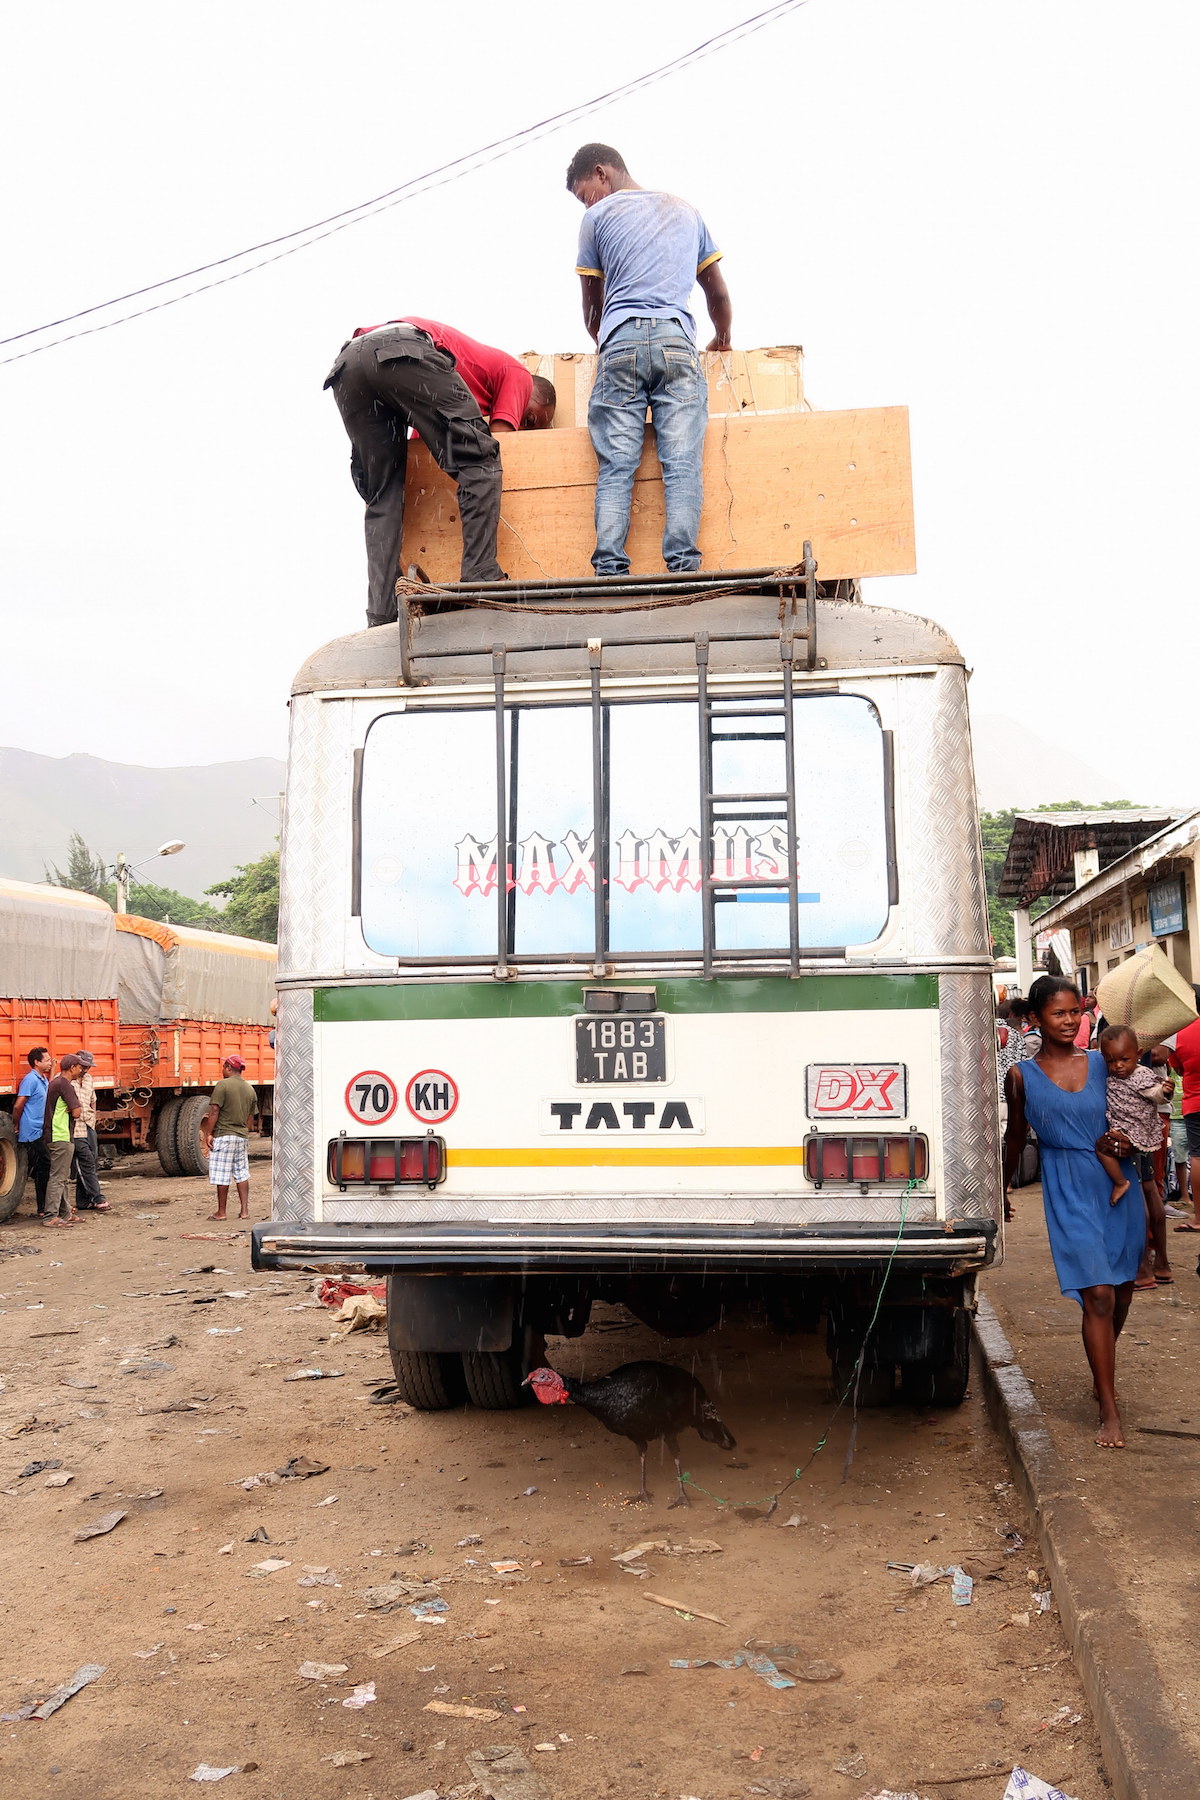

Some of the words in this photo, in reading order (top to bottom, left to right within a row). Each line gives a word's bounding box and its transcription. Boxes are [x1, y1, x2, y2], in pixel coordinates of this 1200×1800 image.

[453, 825, 800, 897] MAXIMUS
[586, 1021, 655, 1048] 1883
[594, 1052, 648, 1079] TAB
[355, 1084, 389, 1112] 70
[415, 1083, 449, 1110] KH
[814, 1070, 899, 1111] DX
[551, 1102, 694, 1129] TATA
